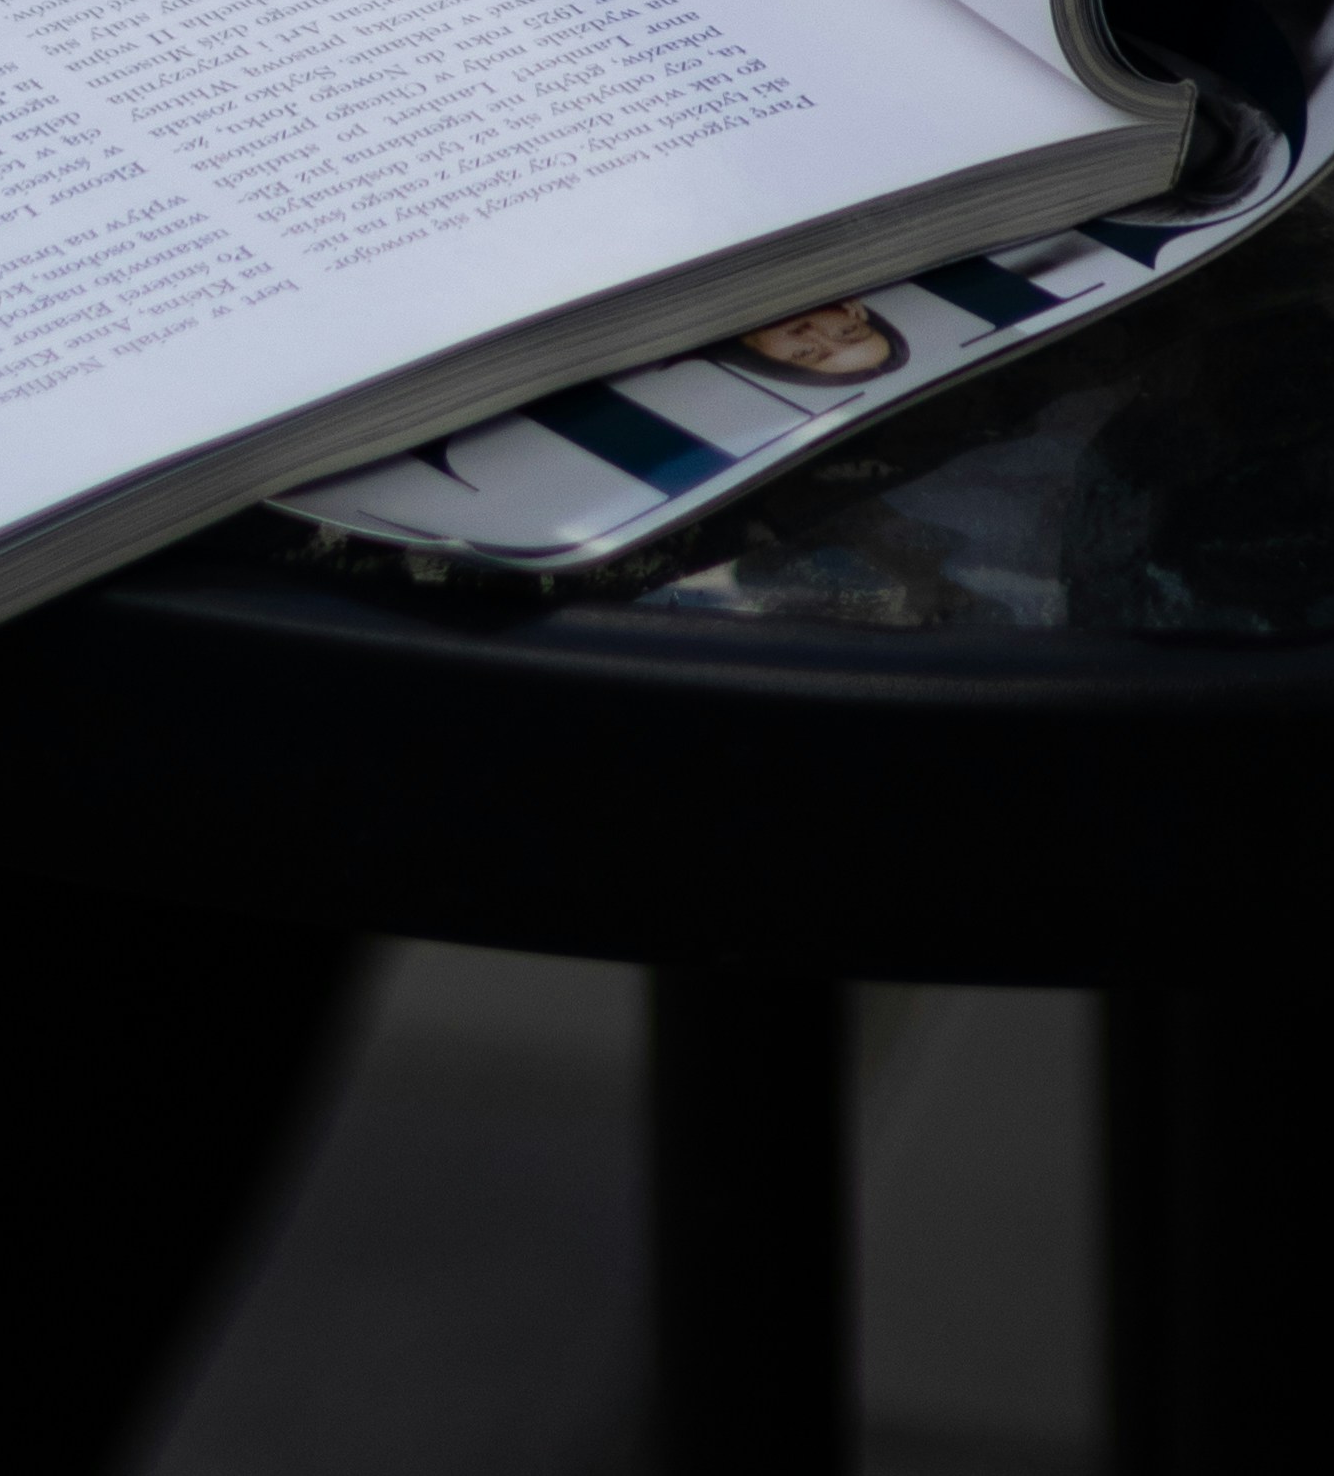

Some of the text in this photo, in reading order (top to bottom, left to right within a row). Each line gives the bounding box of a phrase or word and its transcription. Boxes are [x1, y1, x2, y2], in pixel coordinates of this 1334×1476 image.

[274, 20, 320, 43] Art
[522, 3, 586, 30] 1925
[533, 7, 642, 47] wydziale
[645, 10, 701, 35] anor
[196, 24, 248, 50] dziś
[452, 25, 514, 51] roku
[85, 44, 195, 88] Museum
[239, 33, 347, 77] prasową
[414, 48, 445, 64] do
[462, 44, 528, 73] mody
[663, 57, 703, 77] czy
[735, 57, 767, 75] go
[105, 44, 251, 104] przyczyniła
[243, 64, 337, 102] Szybko
[308, 63, 410, 103] Nowego
[534, 63, 606, 97] gdyby
[686, 72, 734, 92] tak
[749, 76, 790, 98] ski
[130, 79, 239, 122] Whitney
[324, 81, 427, 121] Chicago
[382, 80, 497, 126] Lambert
[485, 93, 526, 112] nie
[549, 73, 655, 116] odbyłoby
[618, 88, 687, 115] wielu
[655, 90, 749, 130] tydzień
[748, 93, 818, 119] Parę
[10, 111, 80, 142] delka
[147, 99, 238, 138] została
[336, 122, 369, 142] po
[502, 112, 542, 130] się
[58, 127, 101, 146] cią
[189, 115, 319, 171] przeniosła
[341, 109, 485, 164] legendarna
[415, 140, 464, 162] tyle
[457, 112, 614, 174] dziennikarzy
[468, 127, 500, 145] aż
[651, 114, 751, 156] tygodni
[0, 155, 90, 197] świecie
[212, 143, 320, 189] studiach
[293, 157, 339, 184] już
[528, 151, 578, 174] Czy
[583, 149, 650, 177] temu
[48, 160, 149, 205] Eleonor
[255, 160, 409, 223] doskonałych
[350, 177, 429, 211] całego
[394, 168, 522, 222] zjechałoby
[473, 172, 581, 219] skończył
[105, 194, 189, 234] wpływ
[135, 211, 210, 242] waną
[352, 217, 388, 235] na
[430, 212, 470, 231] się
[62, 227, 99, 247] na
[92, 228, 231, 287] ustanowiło
[215, 244, 256, 263] Po
[115, 260, 210, 306] śmierci
[237, 260, 274, 280] na
[239, 277, 302, 307] bert
[11, 300, 114, 346] Eleanor
[63, 316, 131, 349] Anne
[108, 315, 199, 358] serialu
